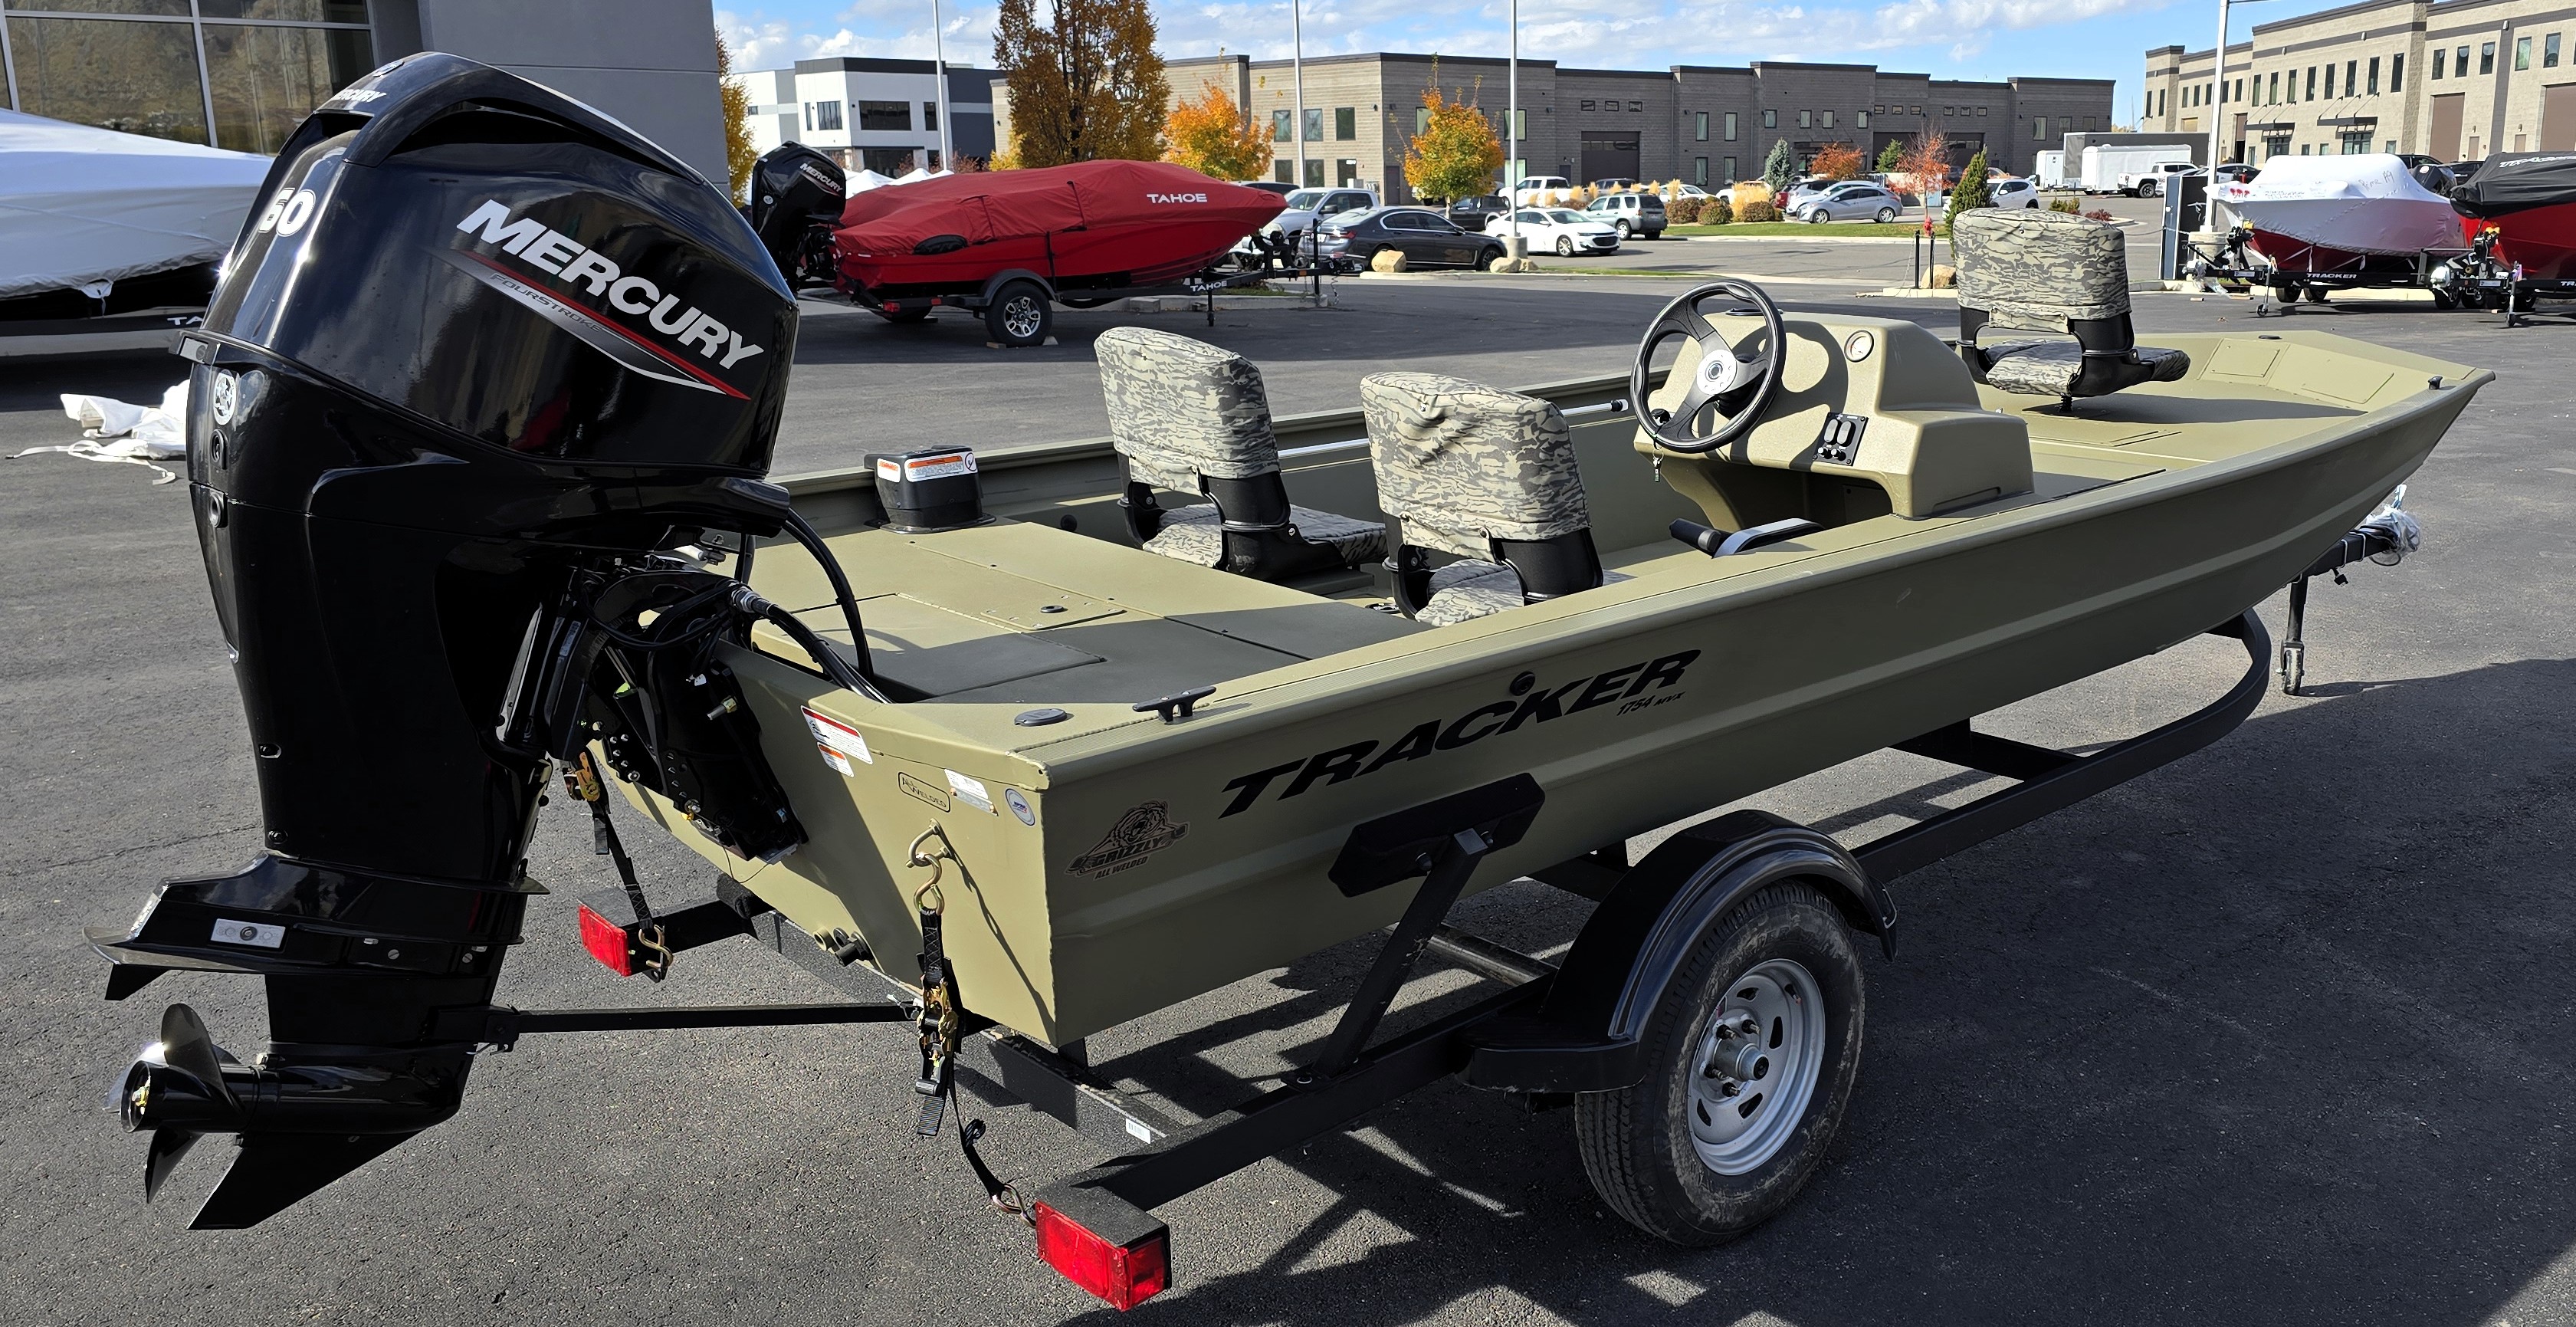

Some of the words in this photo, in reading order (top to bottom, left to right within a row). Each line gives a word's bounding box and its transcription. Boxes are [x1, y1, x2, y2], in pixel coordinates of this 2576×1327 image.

[799, 163, 843, 192] MERCURY
[1146, 193, 1208, 204] TAHOE
[457, 199, 765, 370] MERCURY
[1190, 280, 1227, 291] TAHOE
[489, 273, 606, 333] FOURSTROKE
[1616, 695, 1656, 716] 1754
[1218, 649, 1702, 819] TRACKER
[907, 780, 947, 808] WELDED
[1091, 836, 1163, 868] GRIZZLY
[1094, 867, 1111, 880] ALL
[1111, 856, 1149, 875] WELDED
